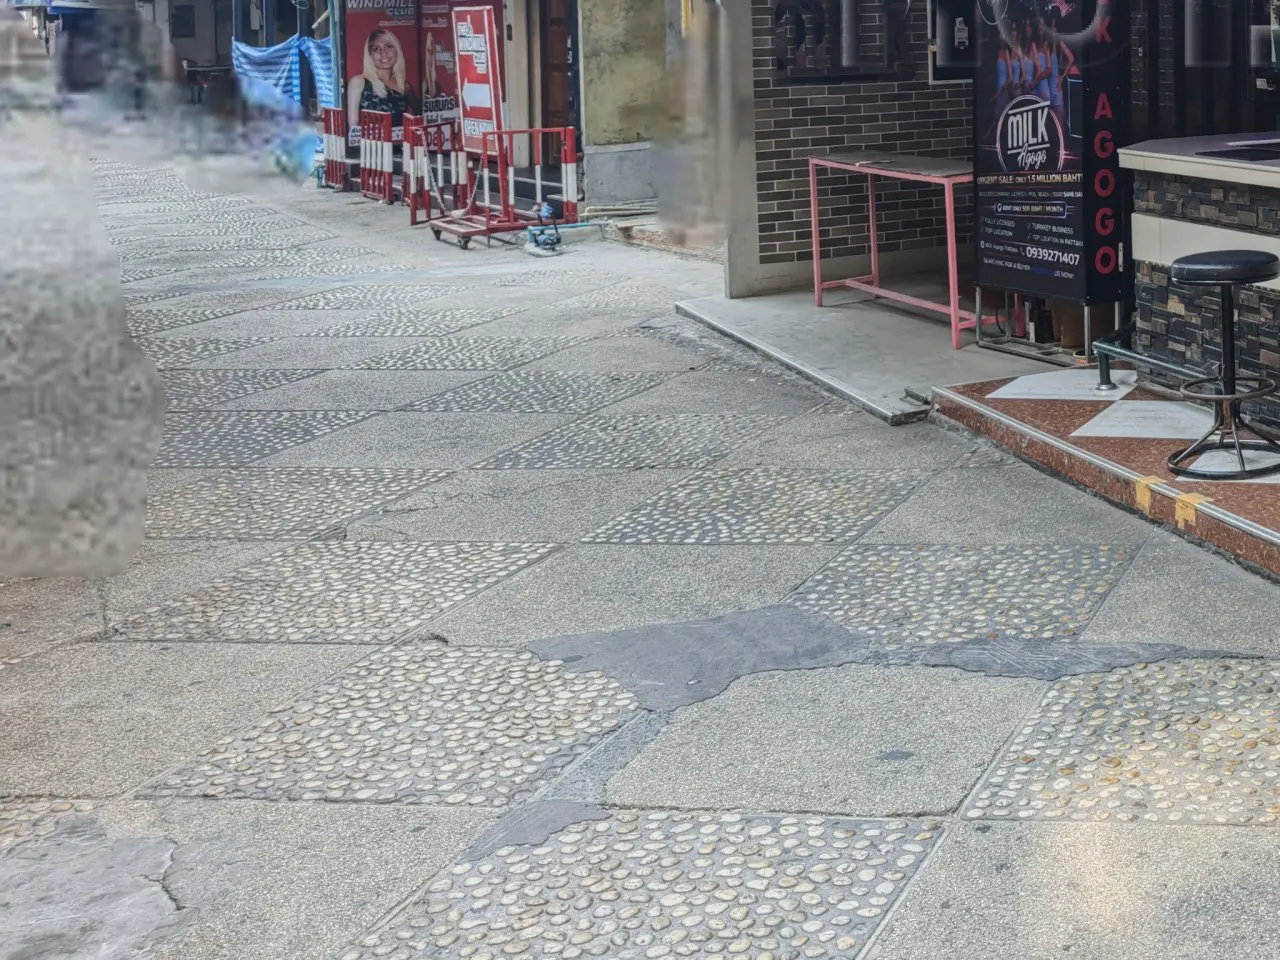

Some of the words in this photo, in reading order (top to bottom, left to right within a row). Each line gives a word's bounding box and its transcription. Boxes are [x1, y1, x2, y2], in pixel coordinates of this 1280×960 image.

[387, 7, 416, 16] CLUB
[1007, 106, 1050, 149] MILK
[1017, 143, 1047, 171] Agogo
[977, 176, 998, 185] URGENT
[1036, 173, 1061, 183] MILLION
[1093, 93, 1117, 274] AGOGO
[1052, 225, 1074, 235] BUSINESS
[1025, 246, 1080, 266] 0939271407
